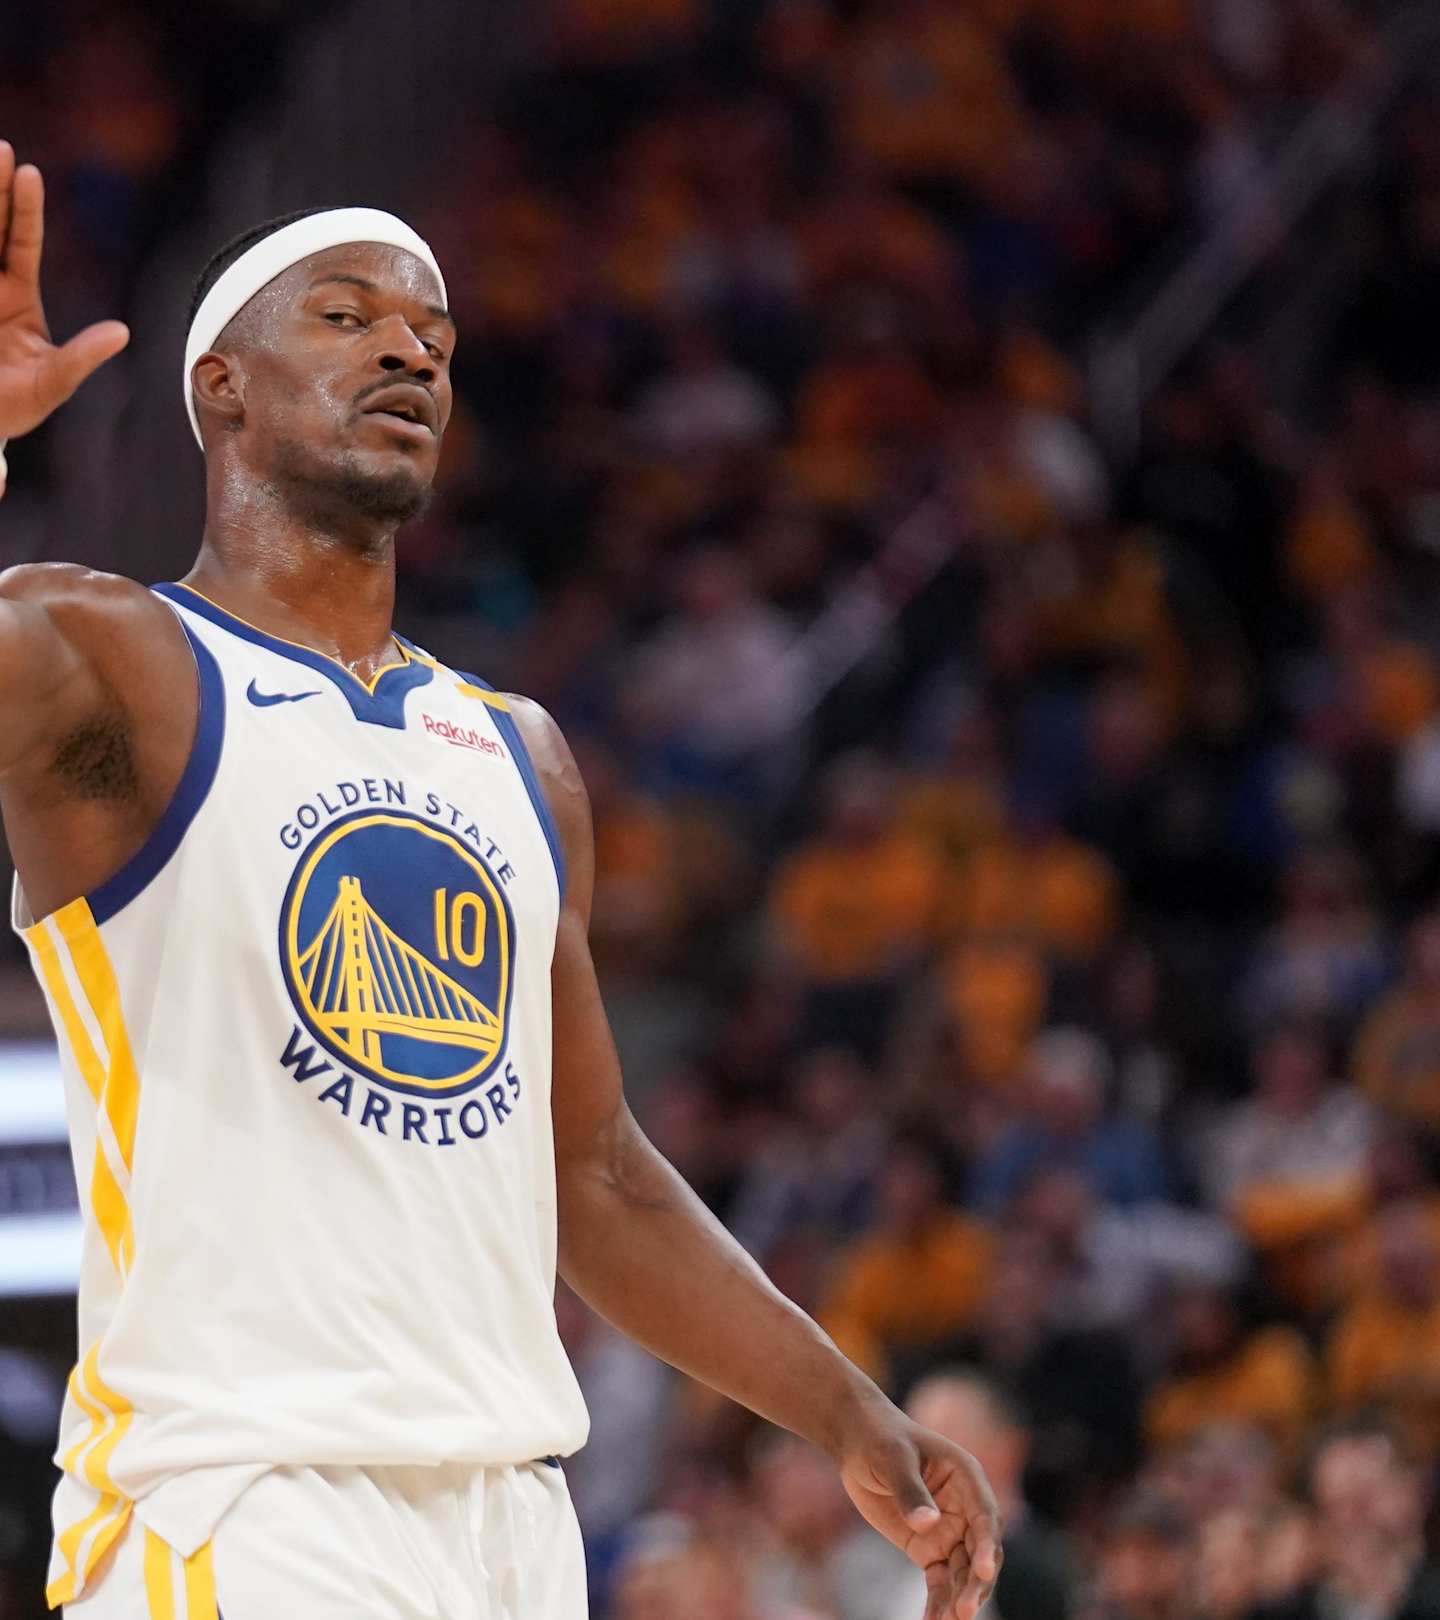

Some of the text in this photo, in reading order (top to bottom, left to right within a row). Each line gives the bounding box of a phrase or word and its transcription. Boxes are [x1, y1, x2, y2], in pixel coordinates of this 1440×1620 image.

[422, 713, 505, 759] Rakuten
[280, 778, 515, 885] GOLDEN STATE
[435, 888, 487, 967] 10
[279, 1024, 520, 1145] WARRIORS
